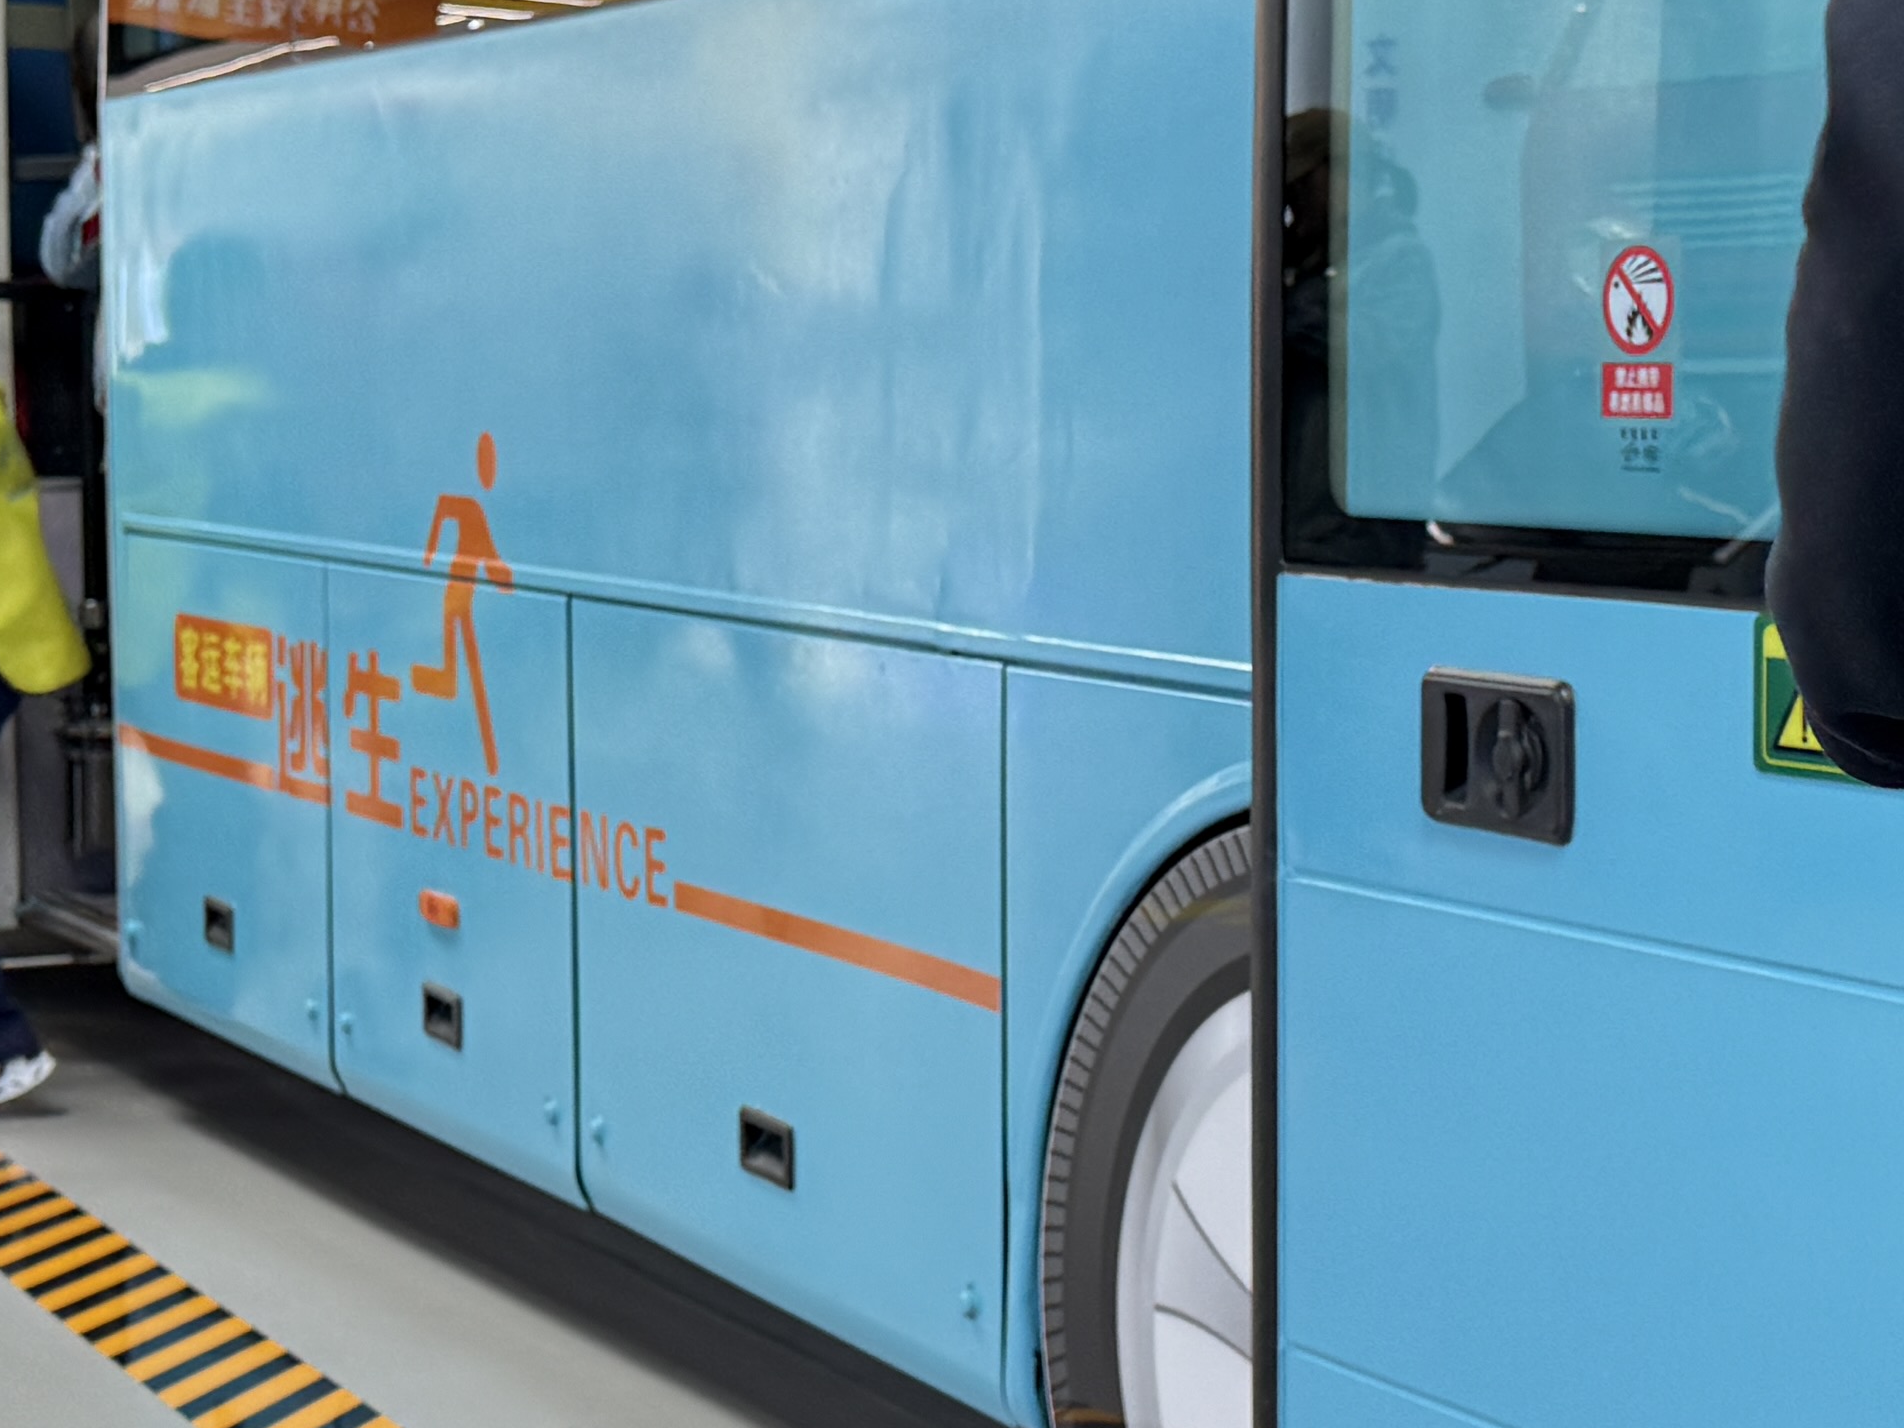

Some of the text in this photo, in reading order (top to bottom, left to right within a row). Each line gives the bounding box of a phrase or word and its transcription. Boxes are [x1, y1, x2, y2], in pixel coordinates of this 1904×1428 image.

[179, 628, 404, 830] 客运车辆 逃生
[409, 765, 669, 909] EXPERIENCE
